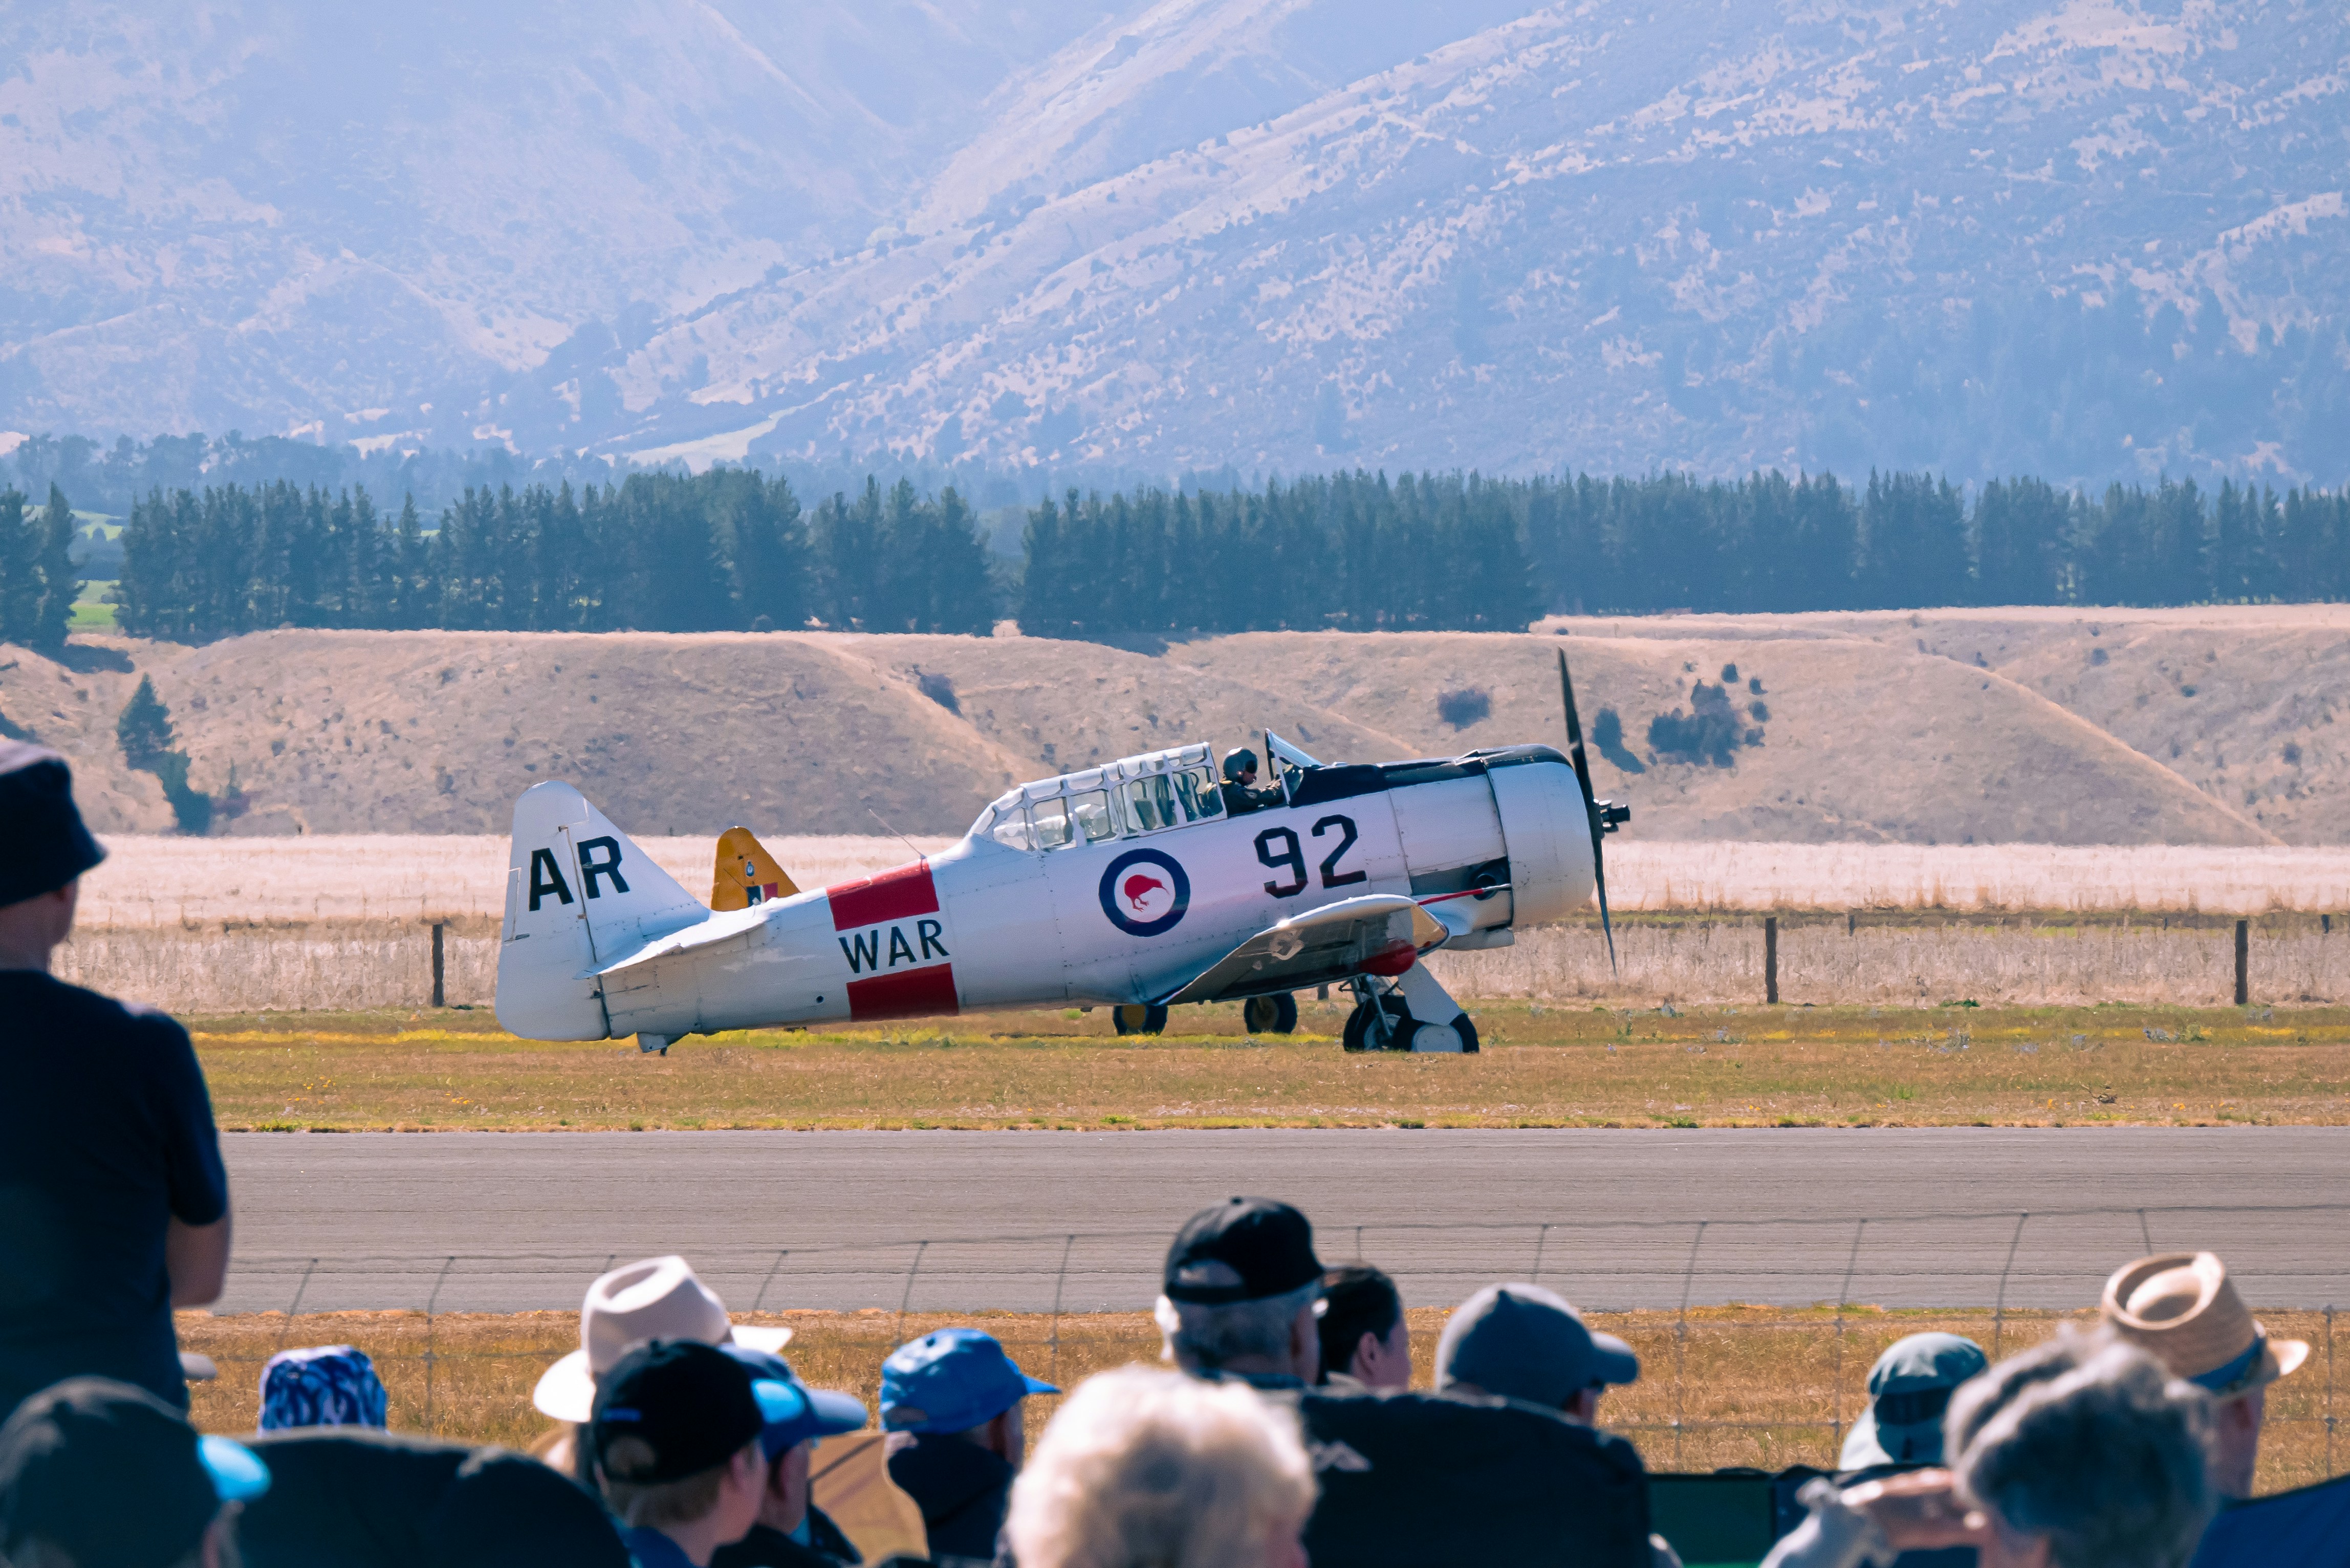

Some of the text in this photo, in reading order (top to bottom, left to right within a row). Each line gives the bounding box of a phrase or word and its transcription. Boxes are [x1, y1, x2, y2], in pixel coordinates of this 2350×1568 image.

[529, 835, 630, 911] AR
[1253, 814, 1367, 899] 92
[838, 919, 950, 973] WAR
